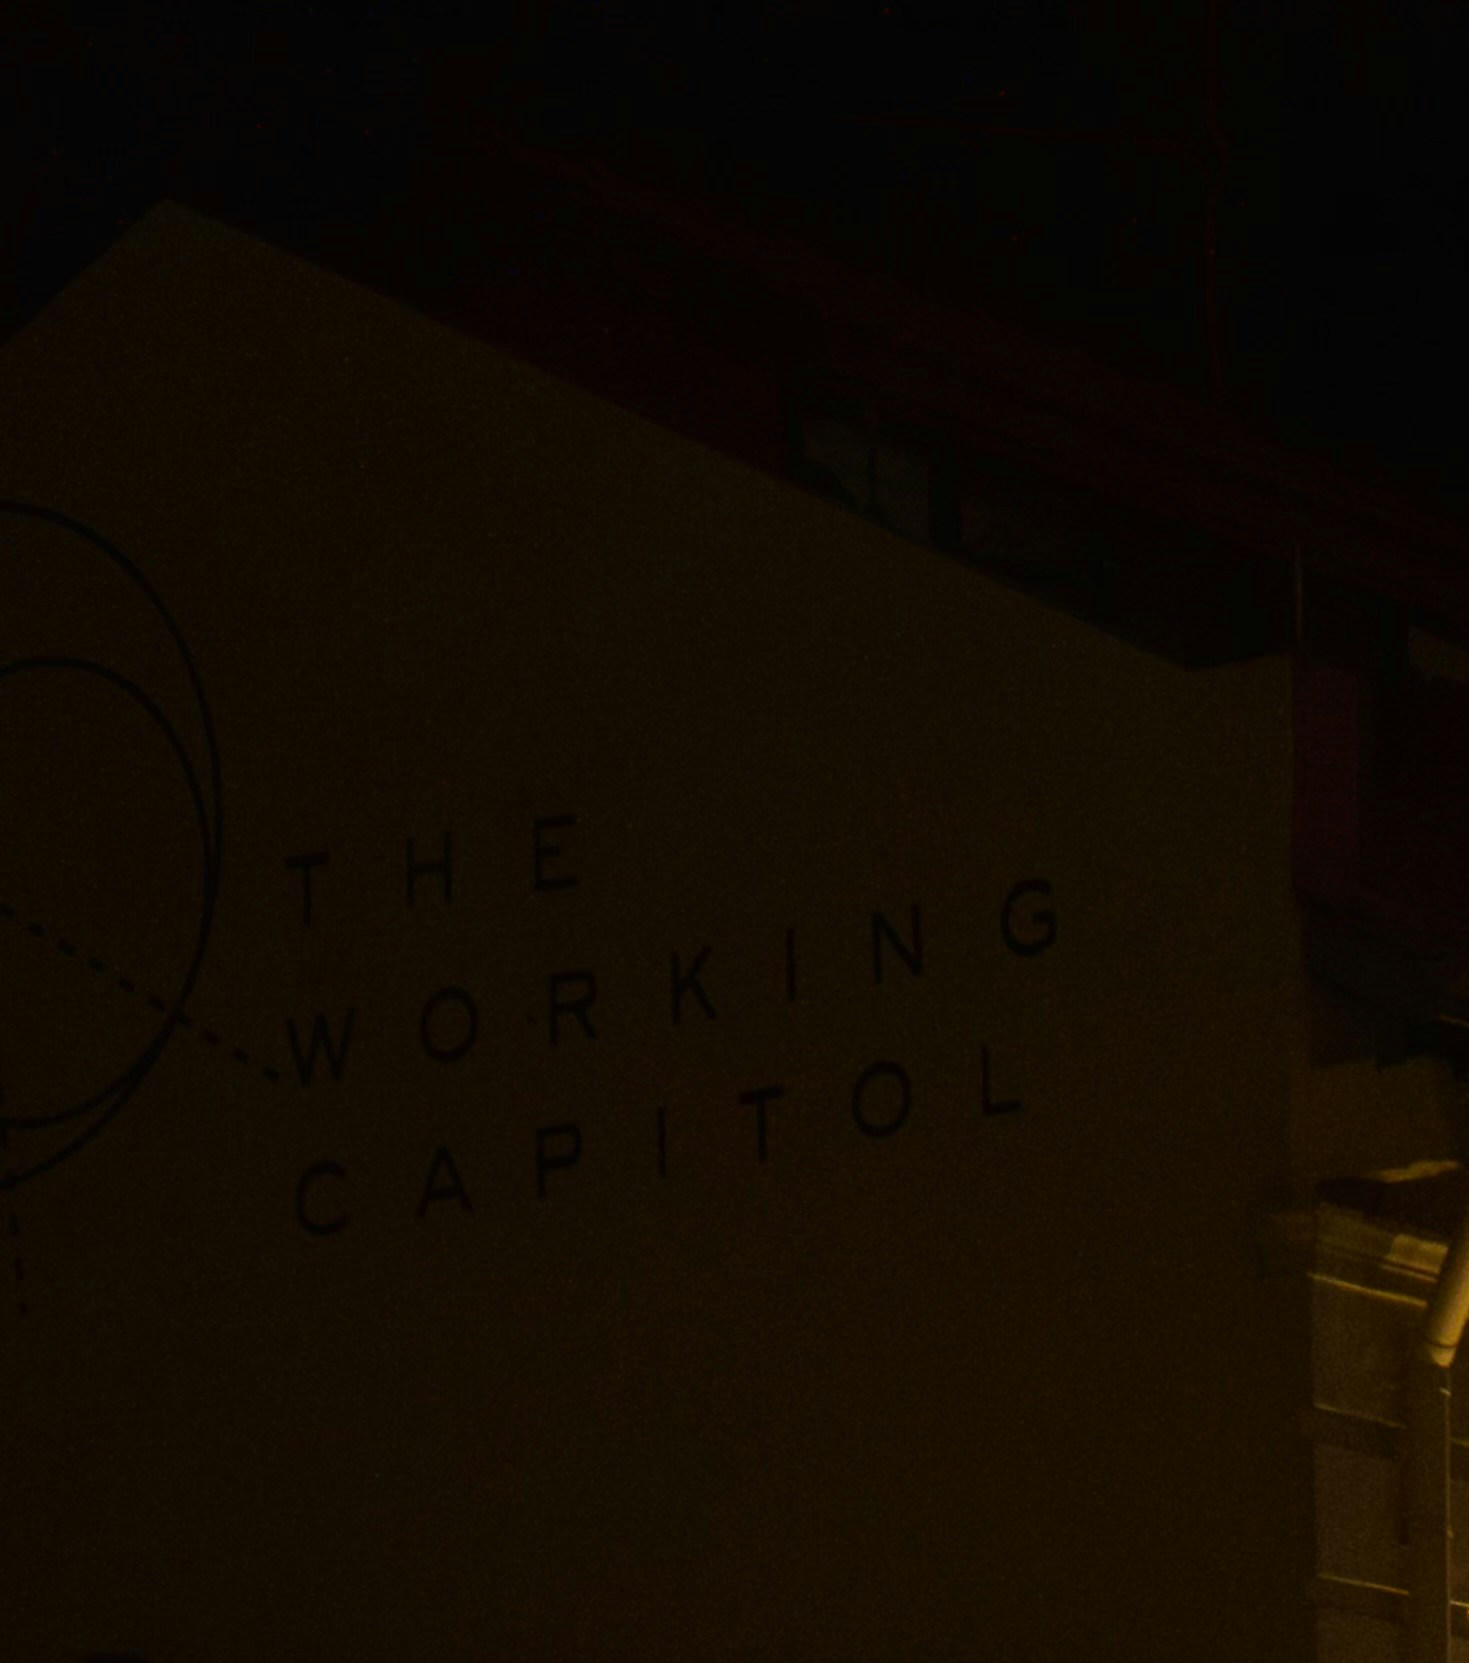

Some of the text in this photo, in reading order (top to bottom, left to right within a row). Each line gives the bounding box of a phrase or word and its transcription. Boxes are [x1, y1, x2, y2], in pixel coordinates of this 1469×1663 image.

[284, 815, 579, 928] THE
[284, 876, 1060, 1090] WORKING
[293, 1045, 1022, 1237] CAPITOL
